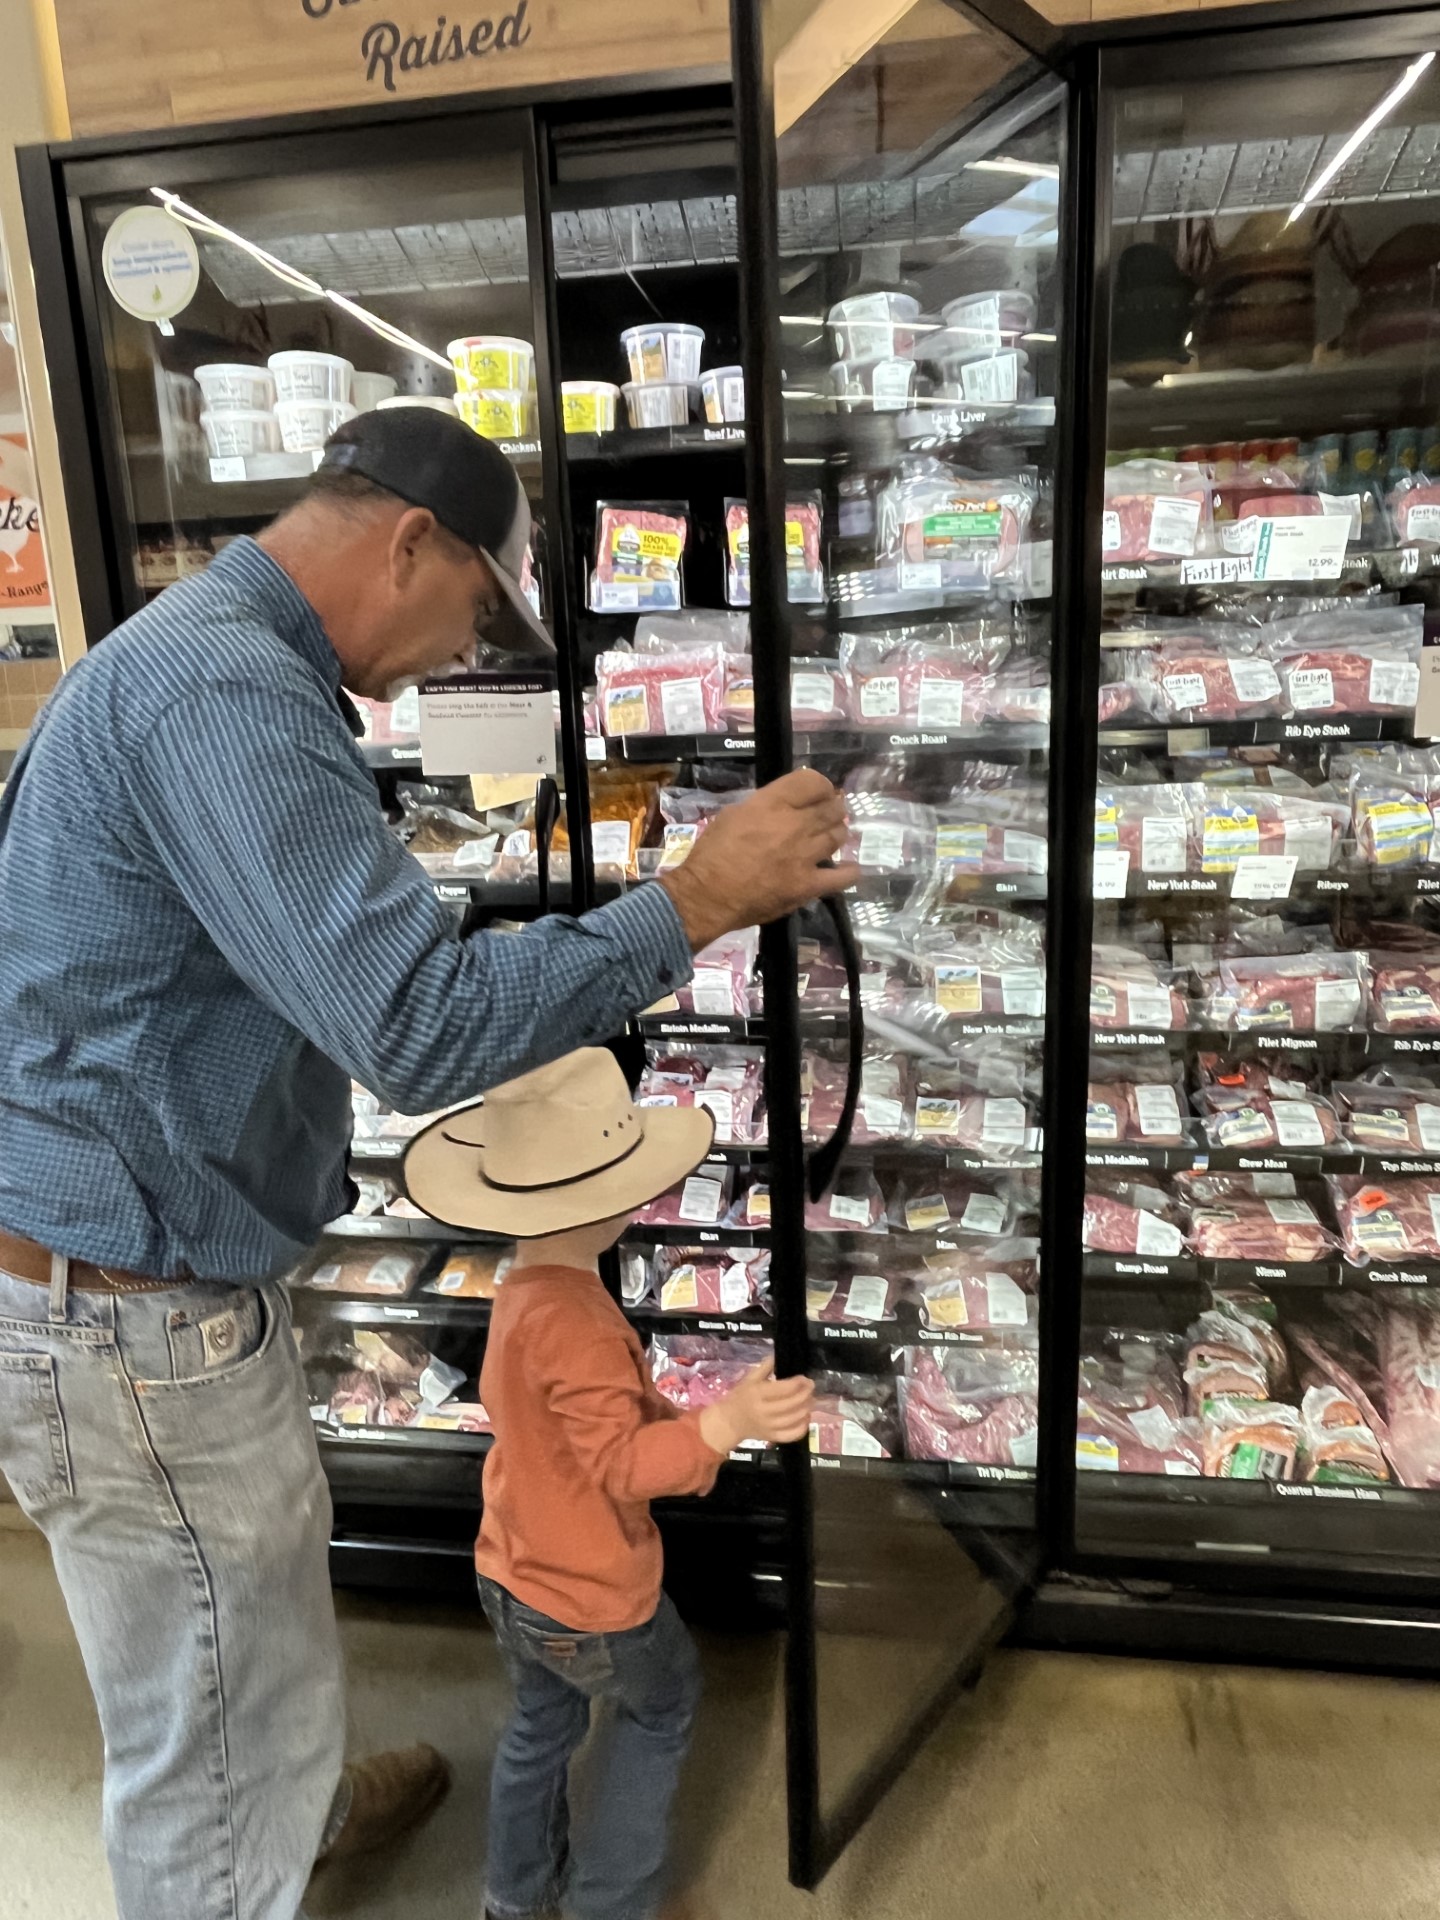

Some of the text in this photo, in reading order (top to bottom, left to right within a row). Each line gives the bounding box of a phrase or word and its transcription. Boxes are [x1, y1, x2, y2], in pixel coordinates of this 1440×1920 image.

[361, 0, 531, 92] Raised
[960, 411, 986, 422] Liver
[704, 428, 725, 440] Beef
[500, 441, 536, 454] Chicken
[1308, 558, 1333, 568] 12.99
[1343, 557, 1368, 569] teak
[1119, 567, 1147, 579] Steak
[1184, 558, 1252, 584] First Light
[1285, 725, 1350, 738] Rib Eye Steak
[890, 734, 948, 746] Chuck Roast
[1148, 880, 1168, 890] New
[1191, 879, 1217, 890] Steak
[1317, 880, 1349, 891] Ribeye
[690, 1024, 730, 1033] Medallion
[963, 1025, 982, 1034] New
[984, 1025, 1004, 1034] York
[1095, 1034, 1165, 1044] New York Steak
[1258, 1037, 1317, 1049] Filet Mignon
[1394, 1040, 1411, 1050] Rib
[1412, 1040, 1431, 1052] Eye
[964, 1160, 981, 1169] Top
[1105, 1155, 1149, 1166] Medallion
[1239, 1159, 1287, 1169] Stew Meat
[1381, 1161, 1399, 1172] Top
[1400, 1161, 1432, 1172] Sirloin
[1116, 1263, 1169, 1276] Rump Roast
[1369, 1271, 1429, 1284] Chuck Roast
[1276, 1483, 1313, 1496] Quarter
